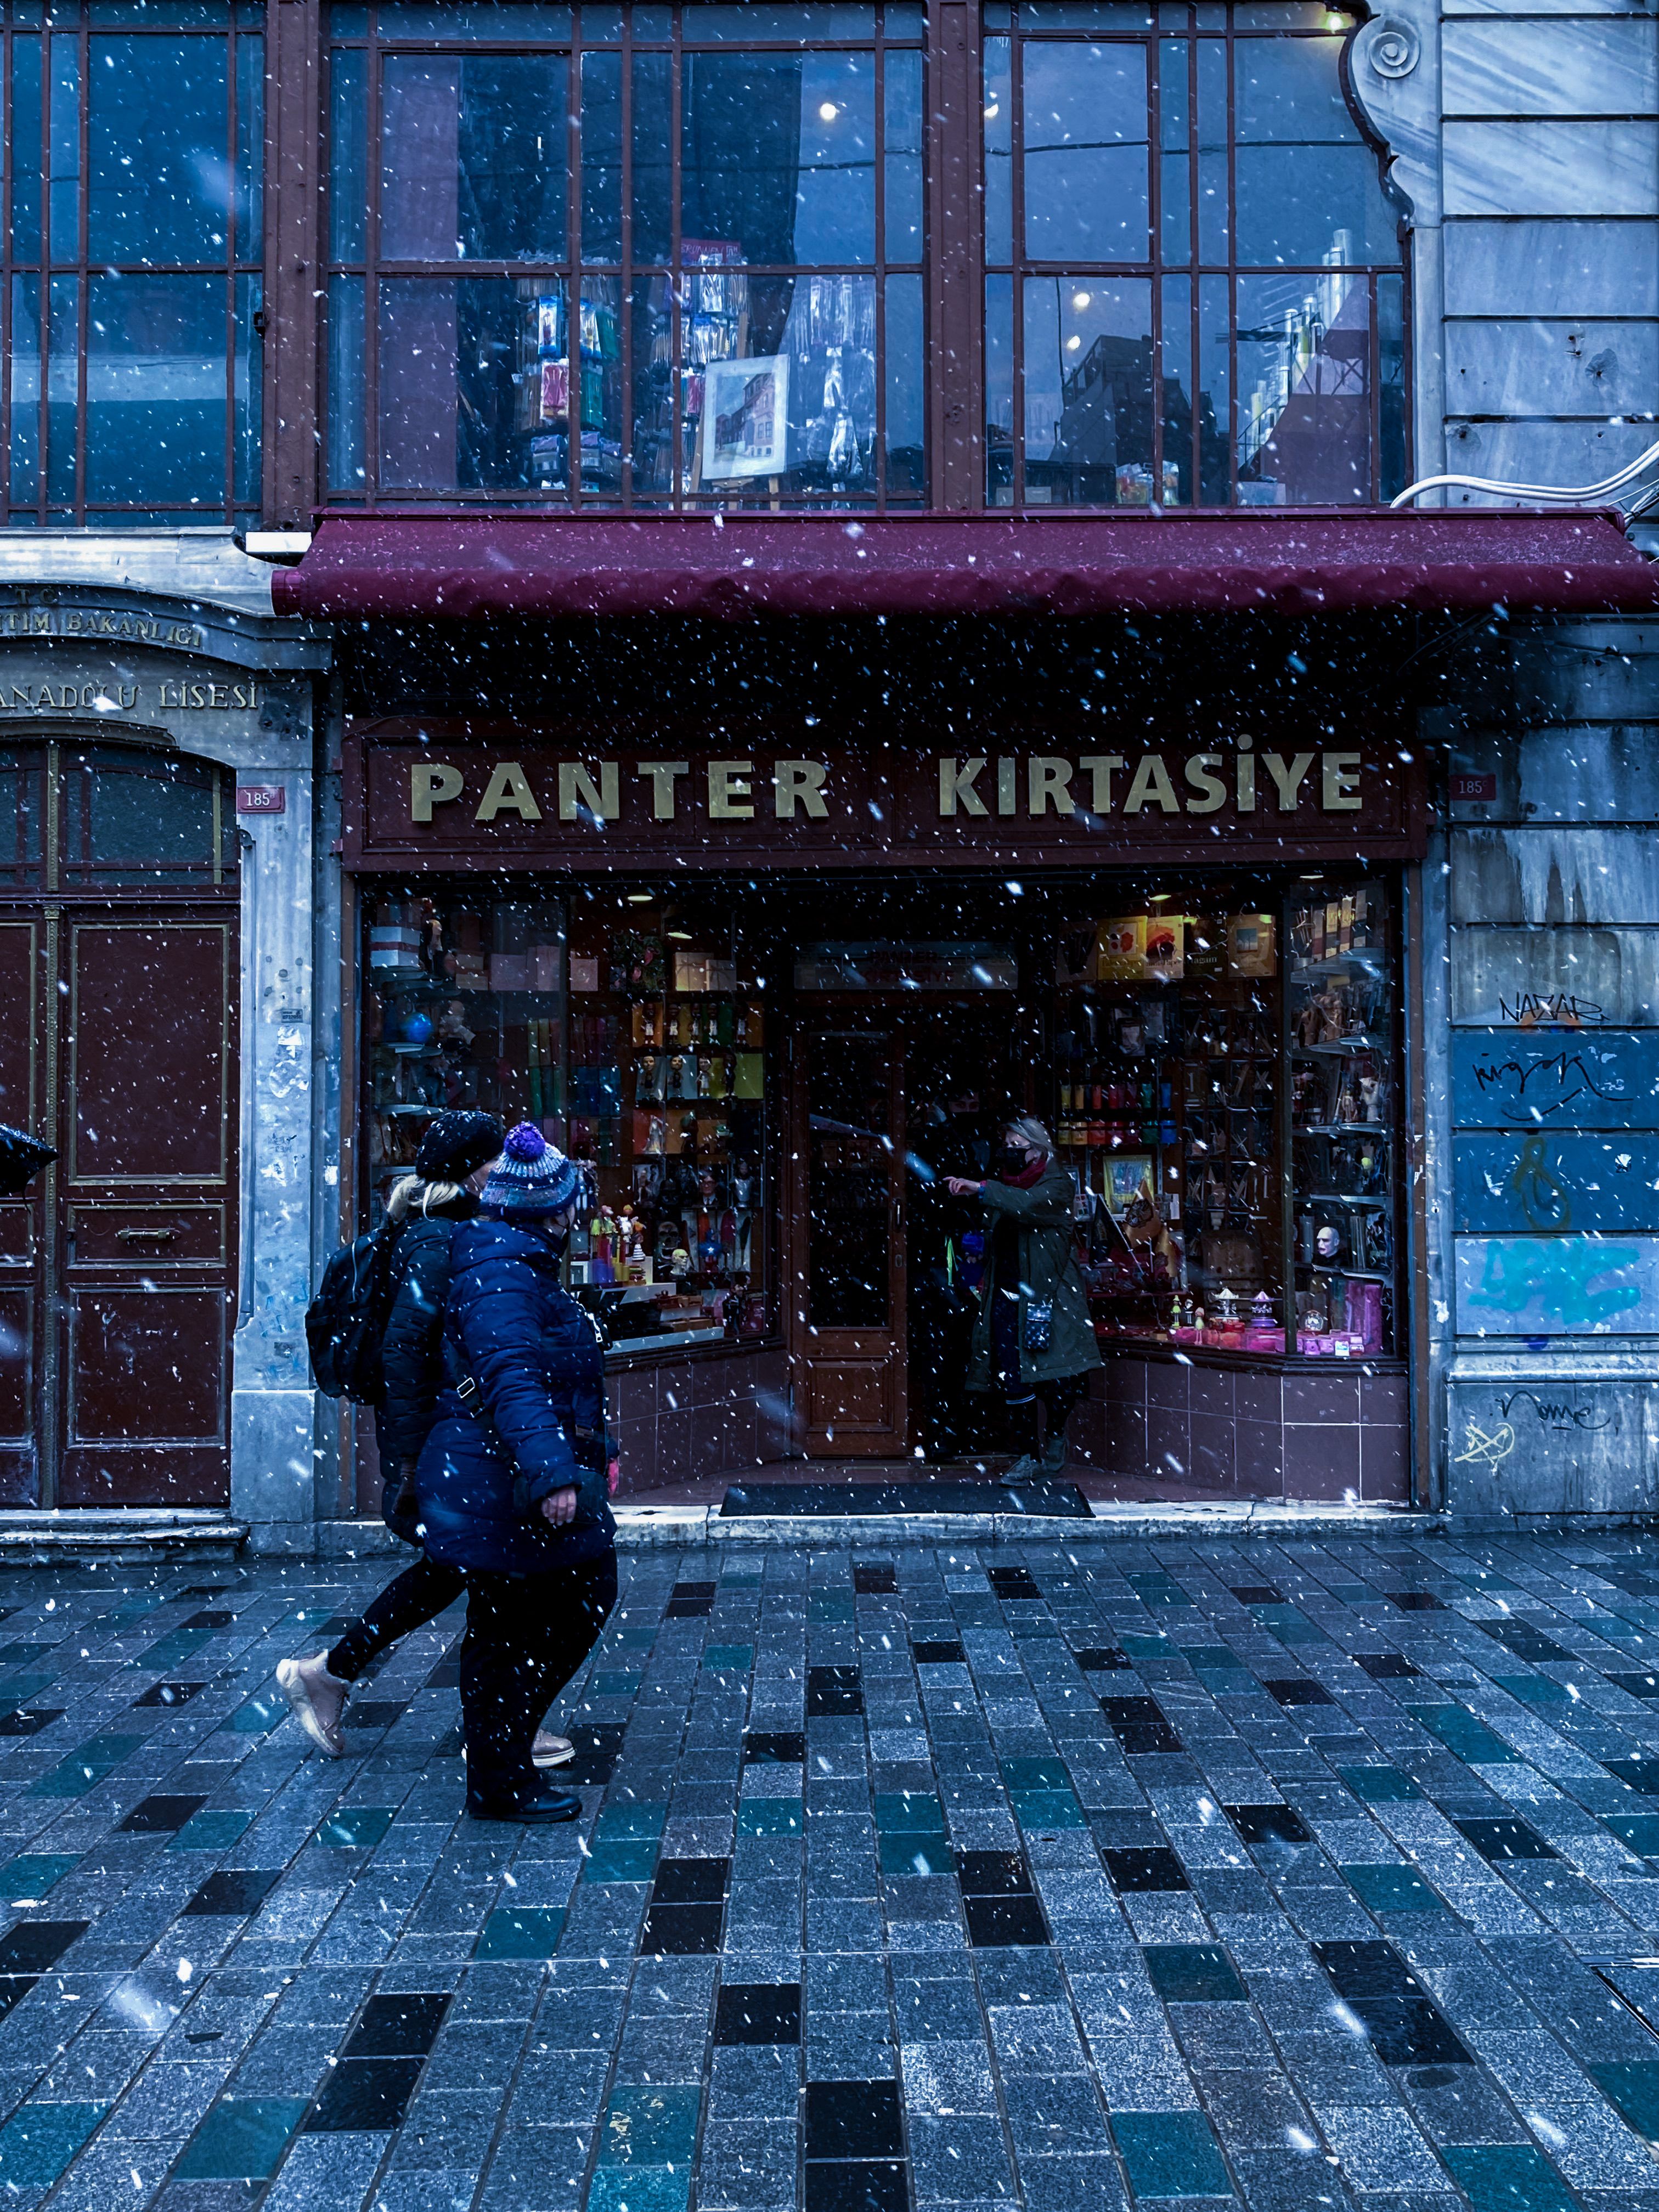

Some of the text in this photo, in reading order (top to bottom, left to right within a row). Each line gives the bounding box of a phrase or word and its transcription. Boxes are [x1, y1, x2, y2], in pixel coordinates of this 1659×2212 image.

[159, 681, 258, 708] LİSESİ
[410, 733, 1363, 822] PANTER KIRTASİYE
[1499, 991, 1611, 1022] NAZAR
